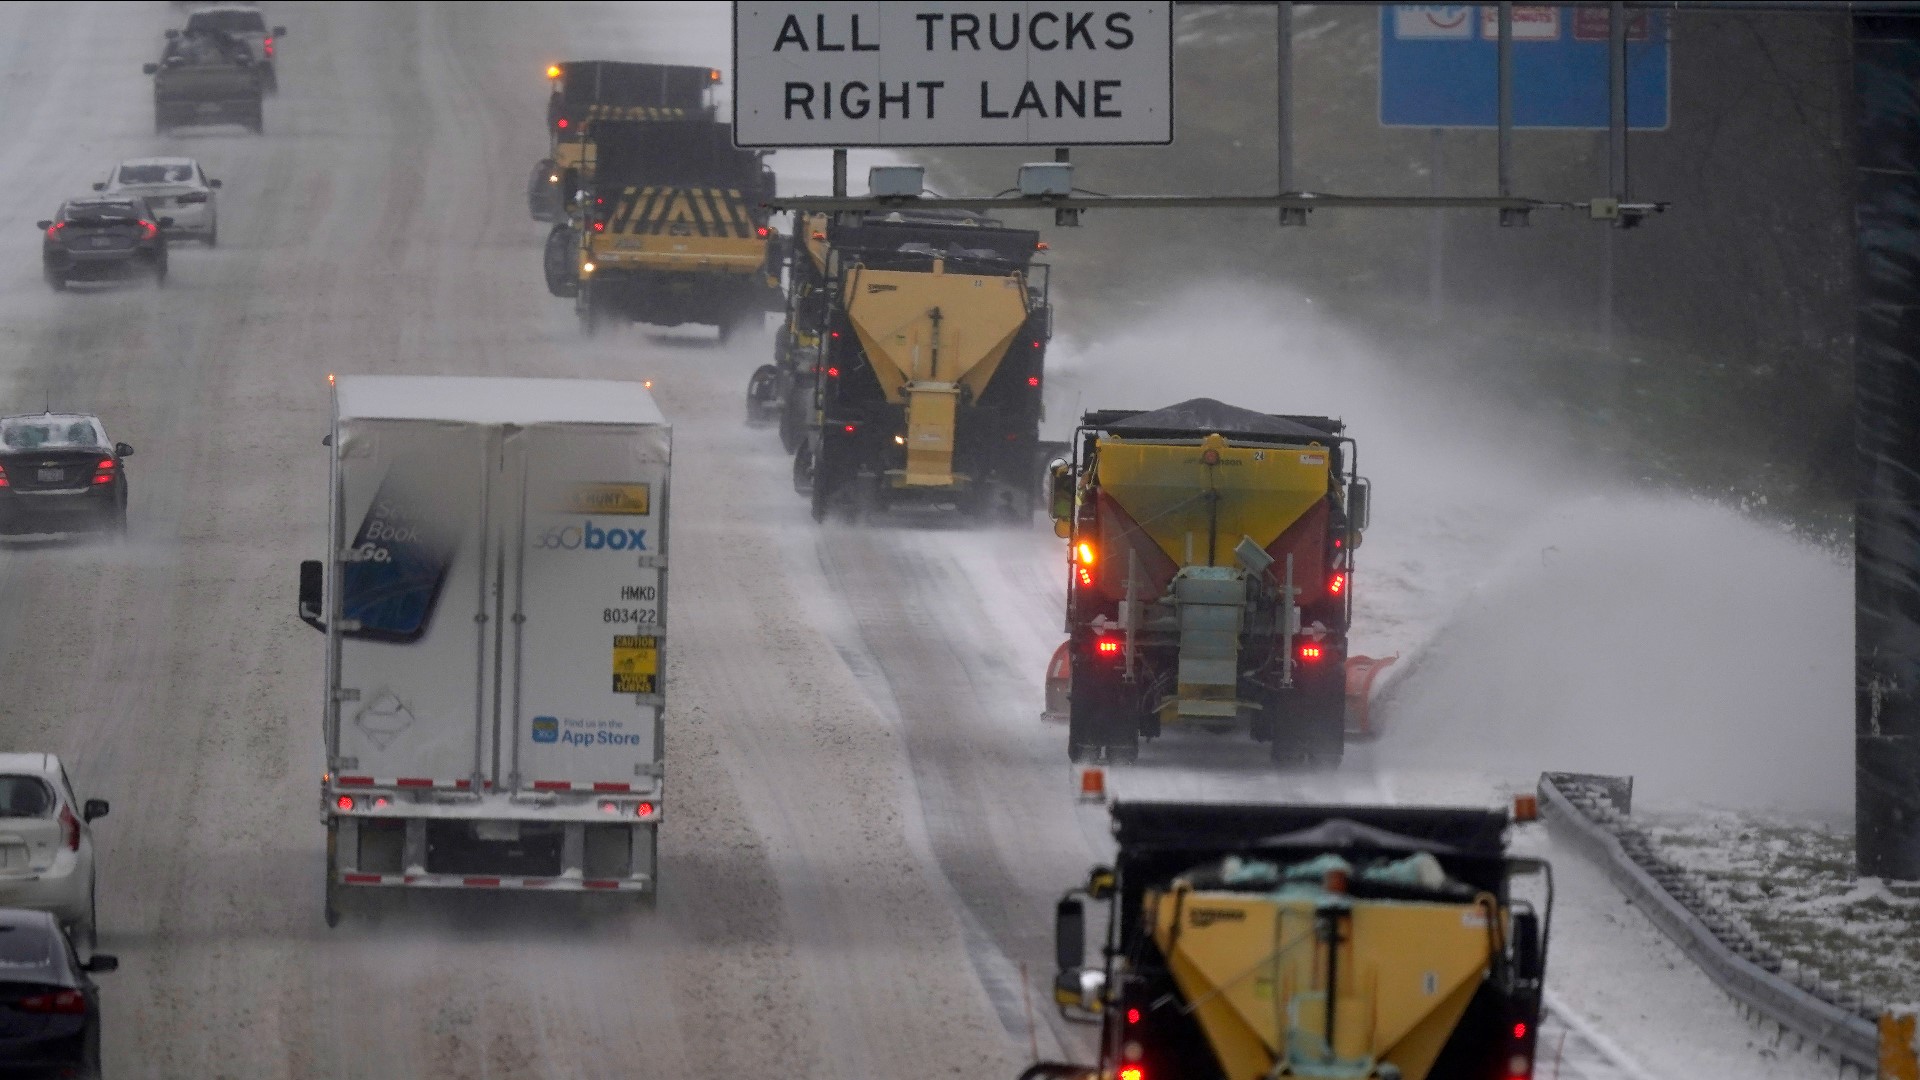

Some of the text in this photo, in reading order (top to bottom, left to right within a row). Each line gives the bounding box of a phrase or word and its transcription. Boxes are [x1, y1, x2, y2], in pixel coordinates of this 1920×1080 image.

[774, 11, 1135, 52] ALL TRUCKS
[784, 79, 1122, 120] RIGHT LANE
[1254, 451, 1265, 460] 24
[360, 542, 392, 564] Go.
[621, 585, 657, 600] HMKD
[603, 608, 657, 624] 803422
[616, 636, 655, 648] CAUTION
[616, 682, 652, 692] TURNS
[564, 718, 624, 729] Find us in the
[562, 730, 595, 747] App
[597, 730, 640, 746] Store
